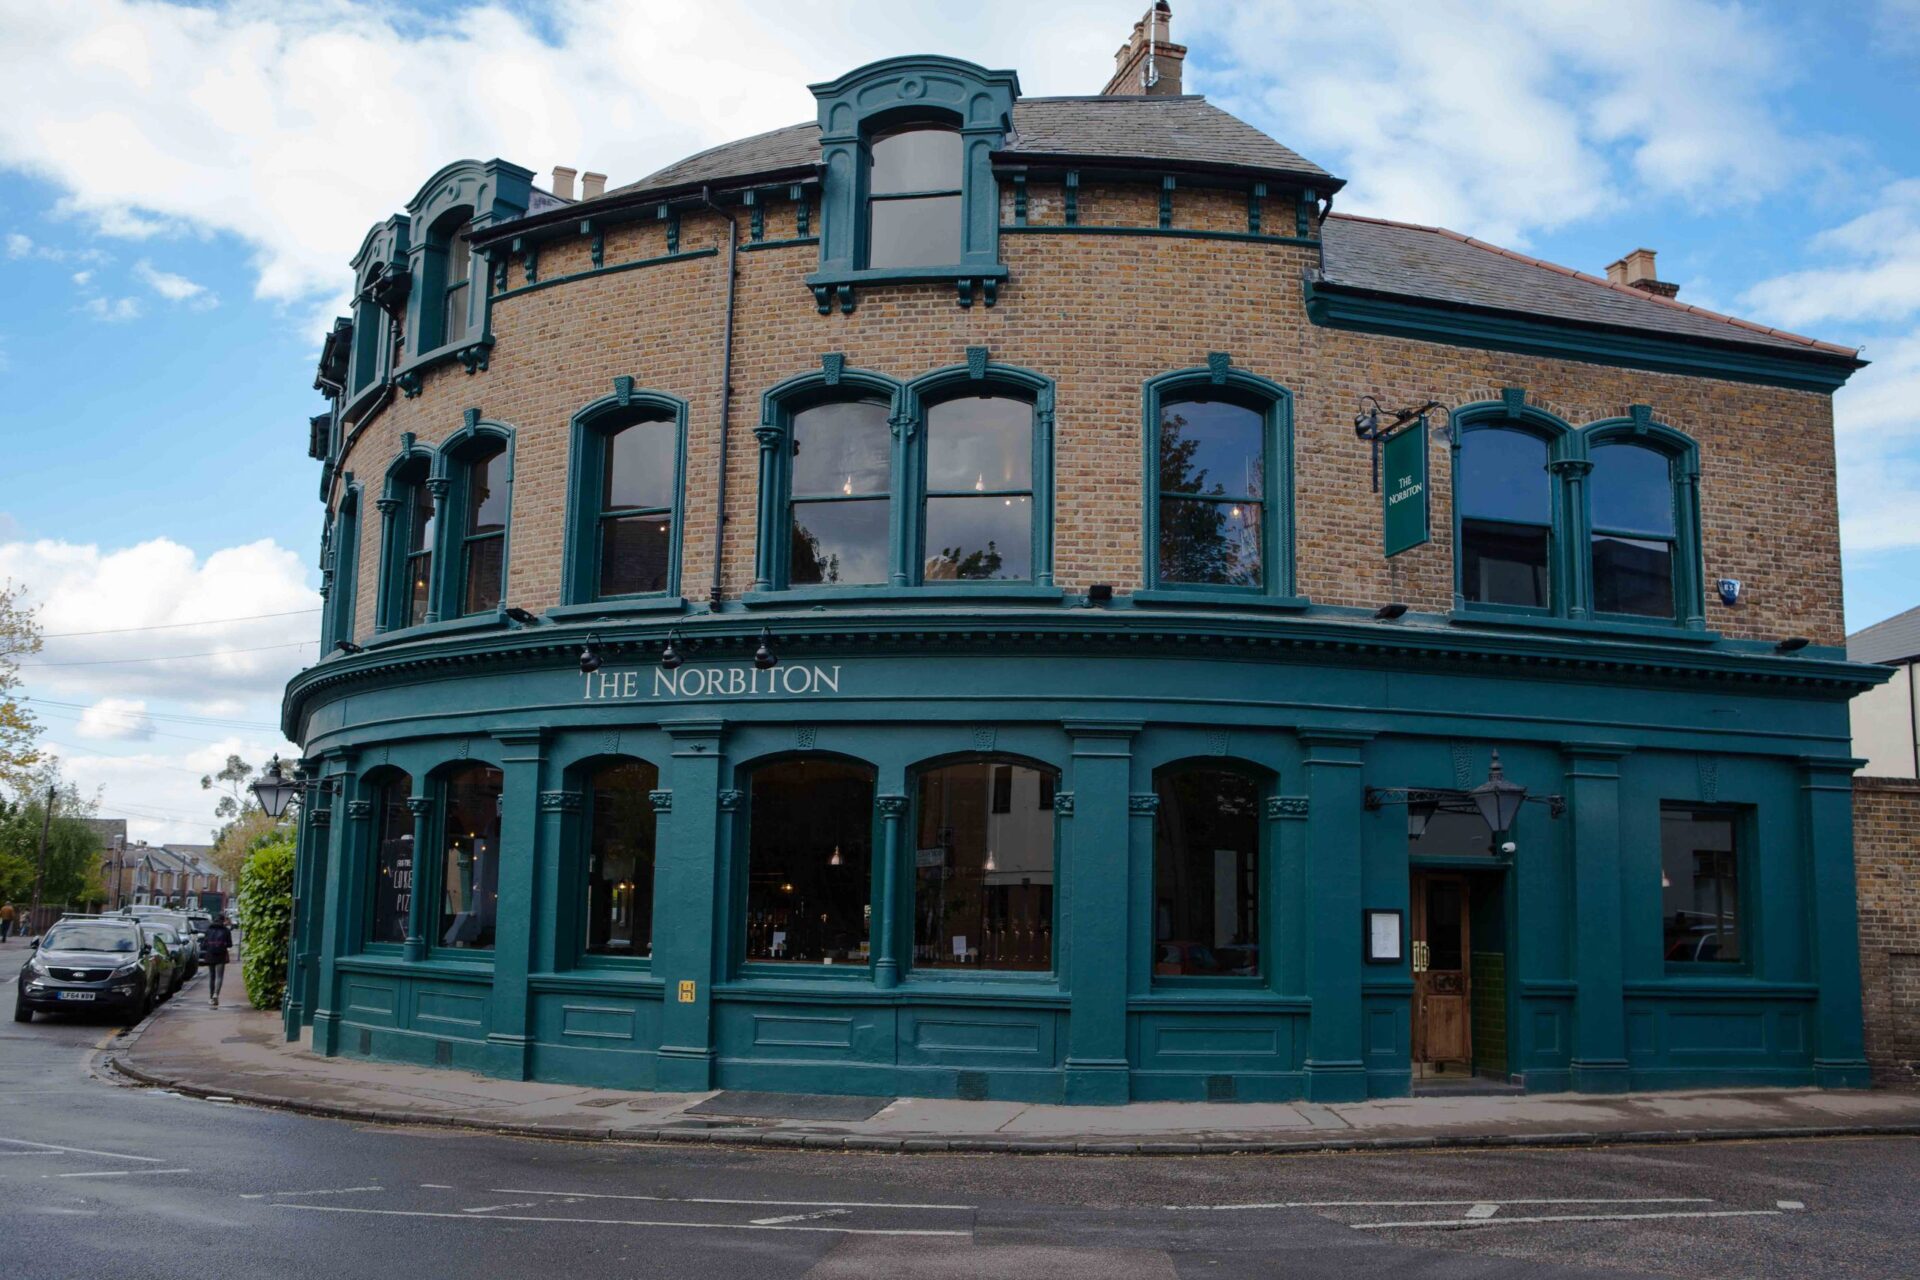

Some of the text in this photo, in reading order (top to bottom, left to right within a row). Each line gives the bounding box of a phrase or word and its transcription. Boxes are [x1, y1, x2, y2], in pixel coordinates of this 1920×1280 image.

[1388, 482, 1423, 506] NORBITON
[1398, 475, 1412, 489] THE
[579, 665, 842, 699] THE NORBITON
